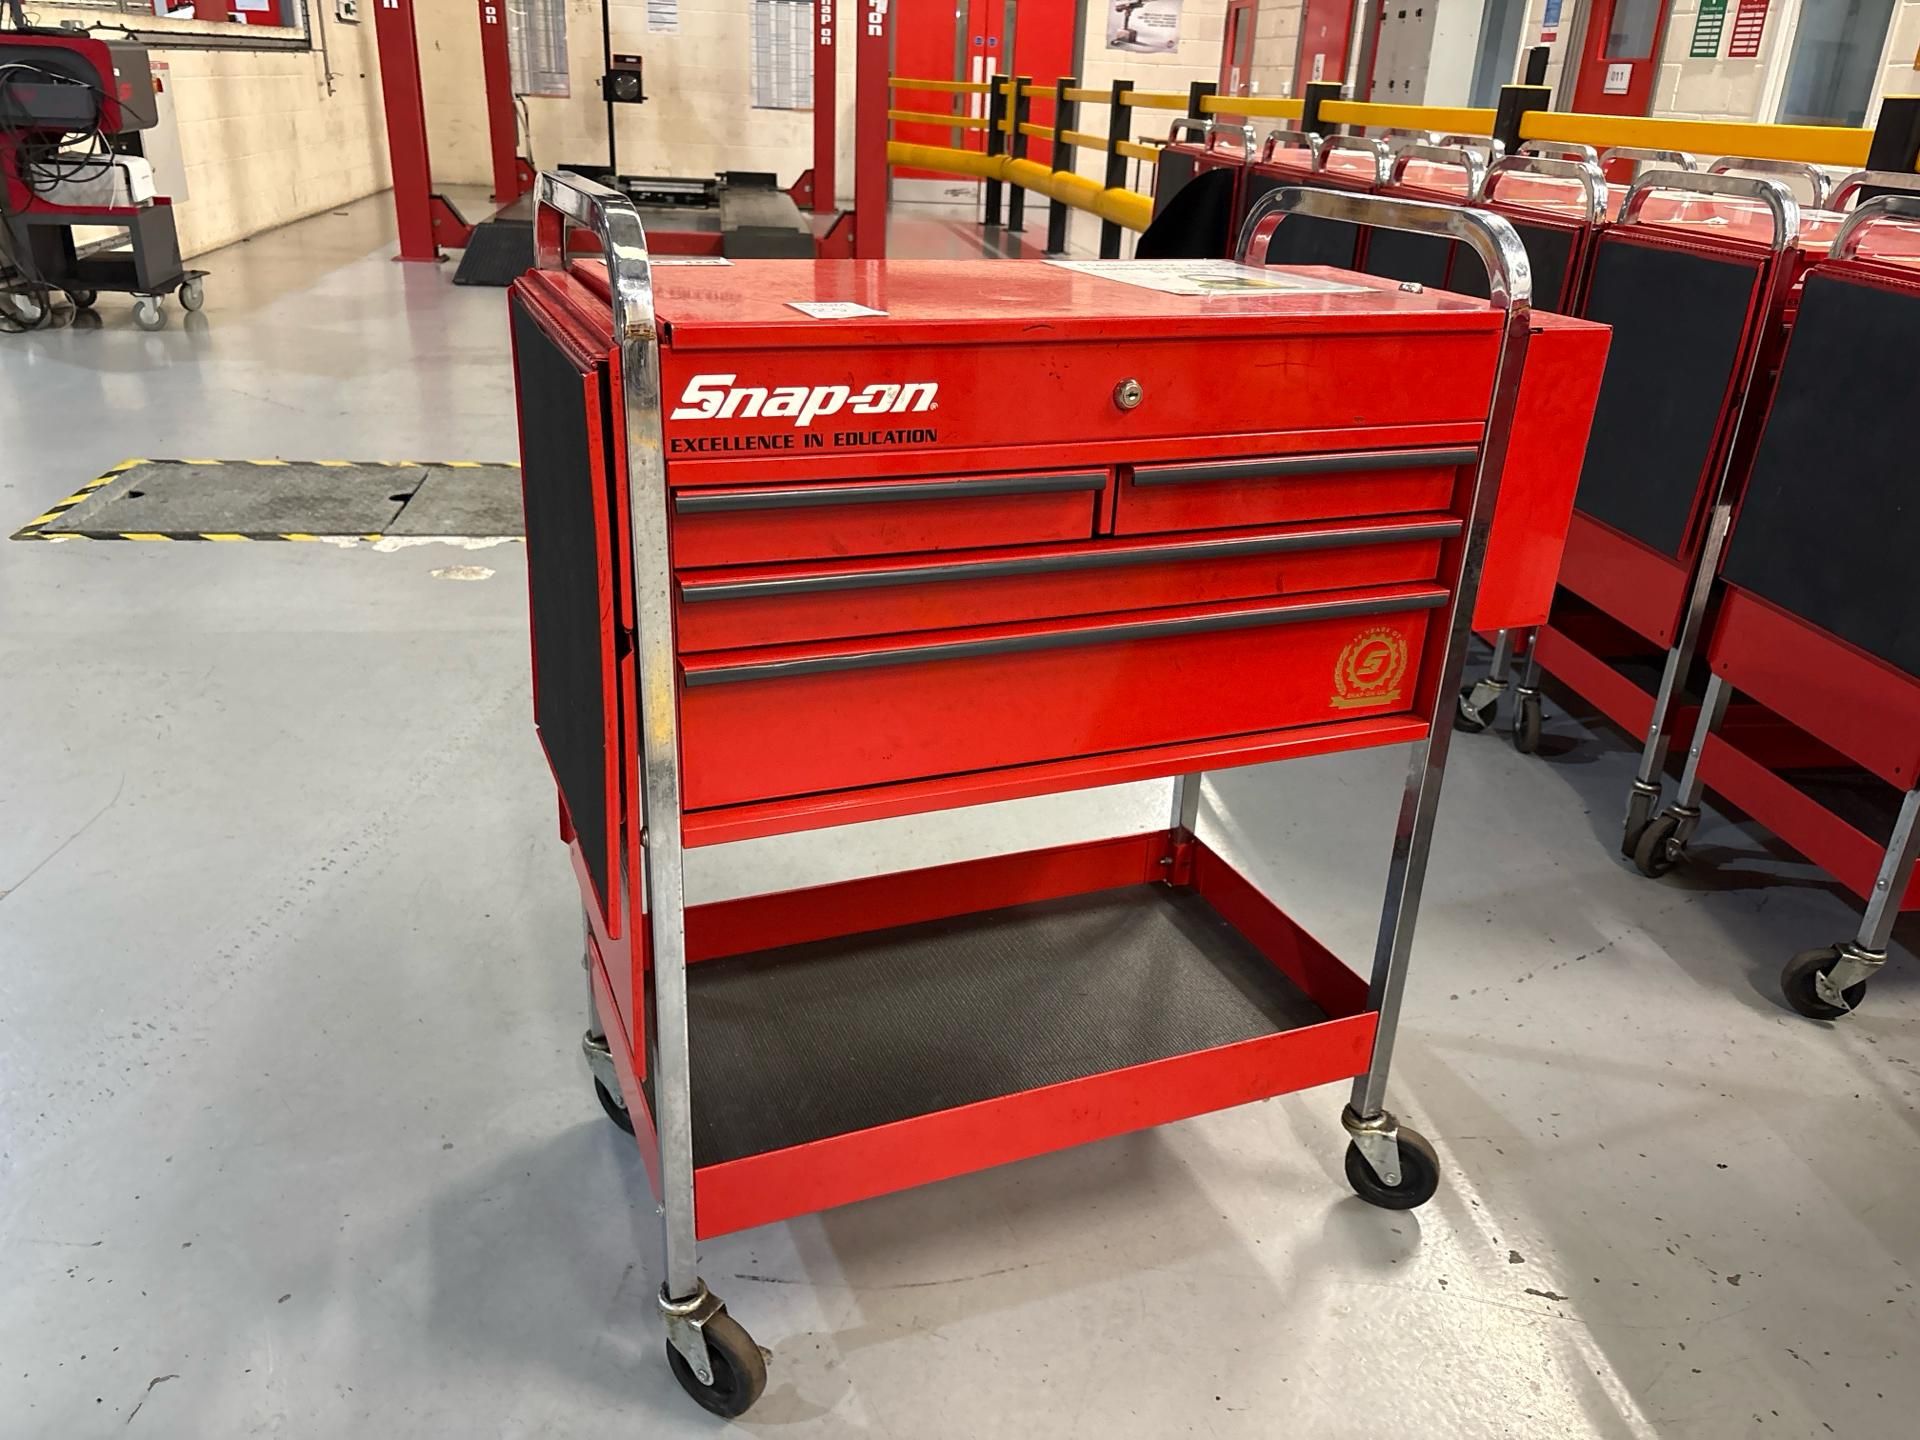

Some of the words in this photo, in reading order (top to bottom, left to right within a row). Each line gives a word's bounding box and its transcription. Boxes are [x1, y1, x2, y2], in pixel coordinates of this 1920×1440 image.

[868, 12, 882, 36] on
[820, 28, 832, 46] on
[670, 434, 795, 453] EXCELLENCE
[804, 433, 824, 448] IN
[833, 428, 938, 447] EDUCATION
